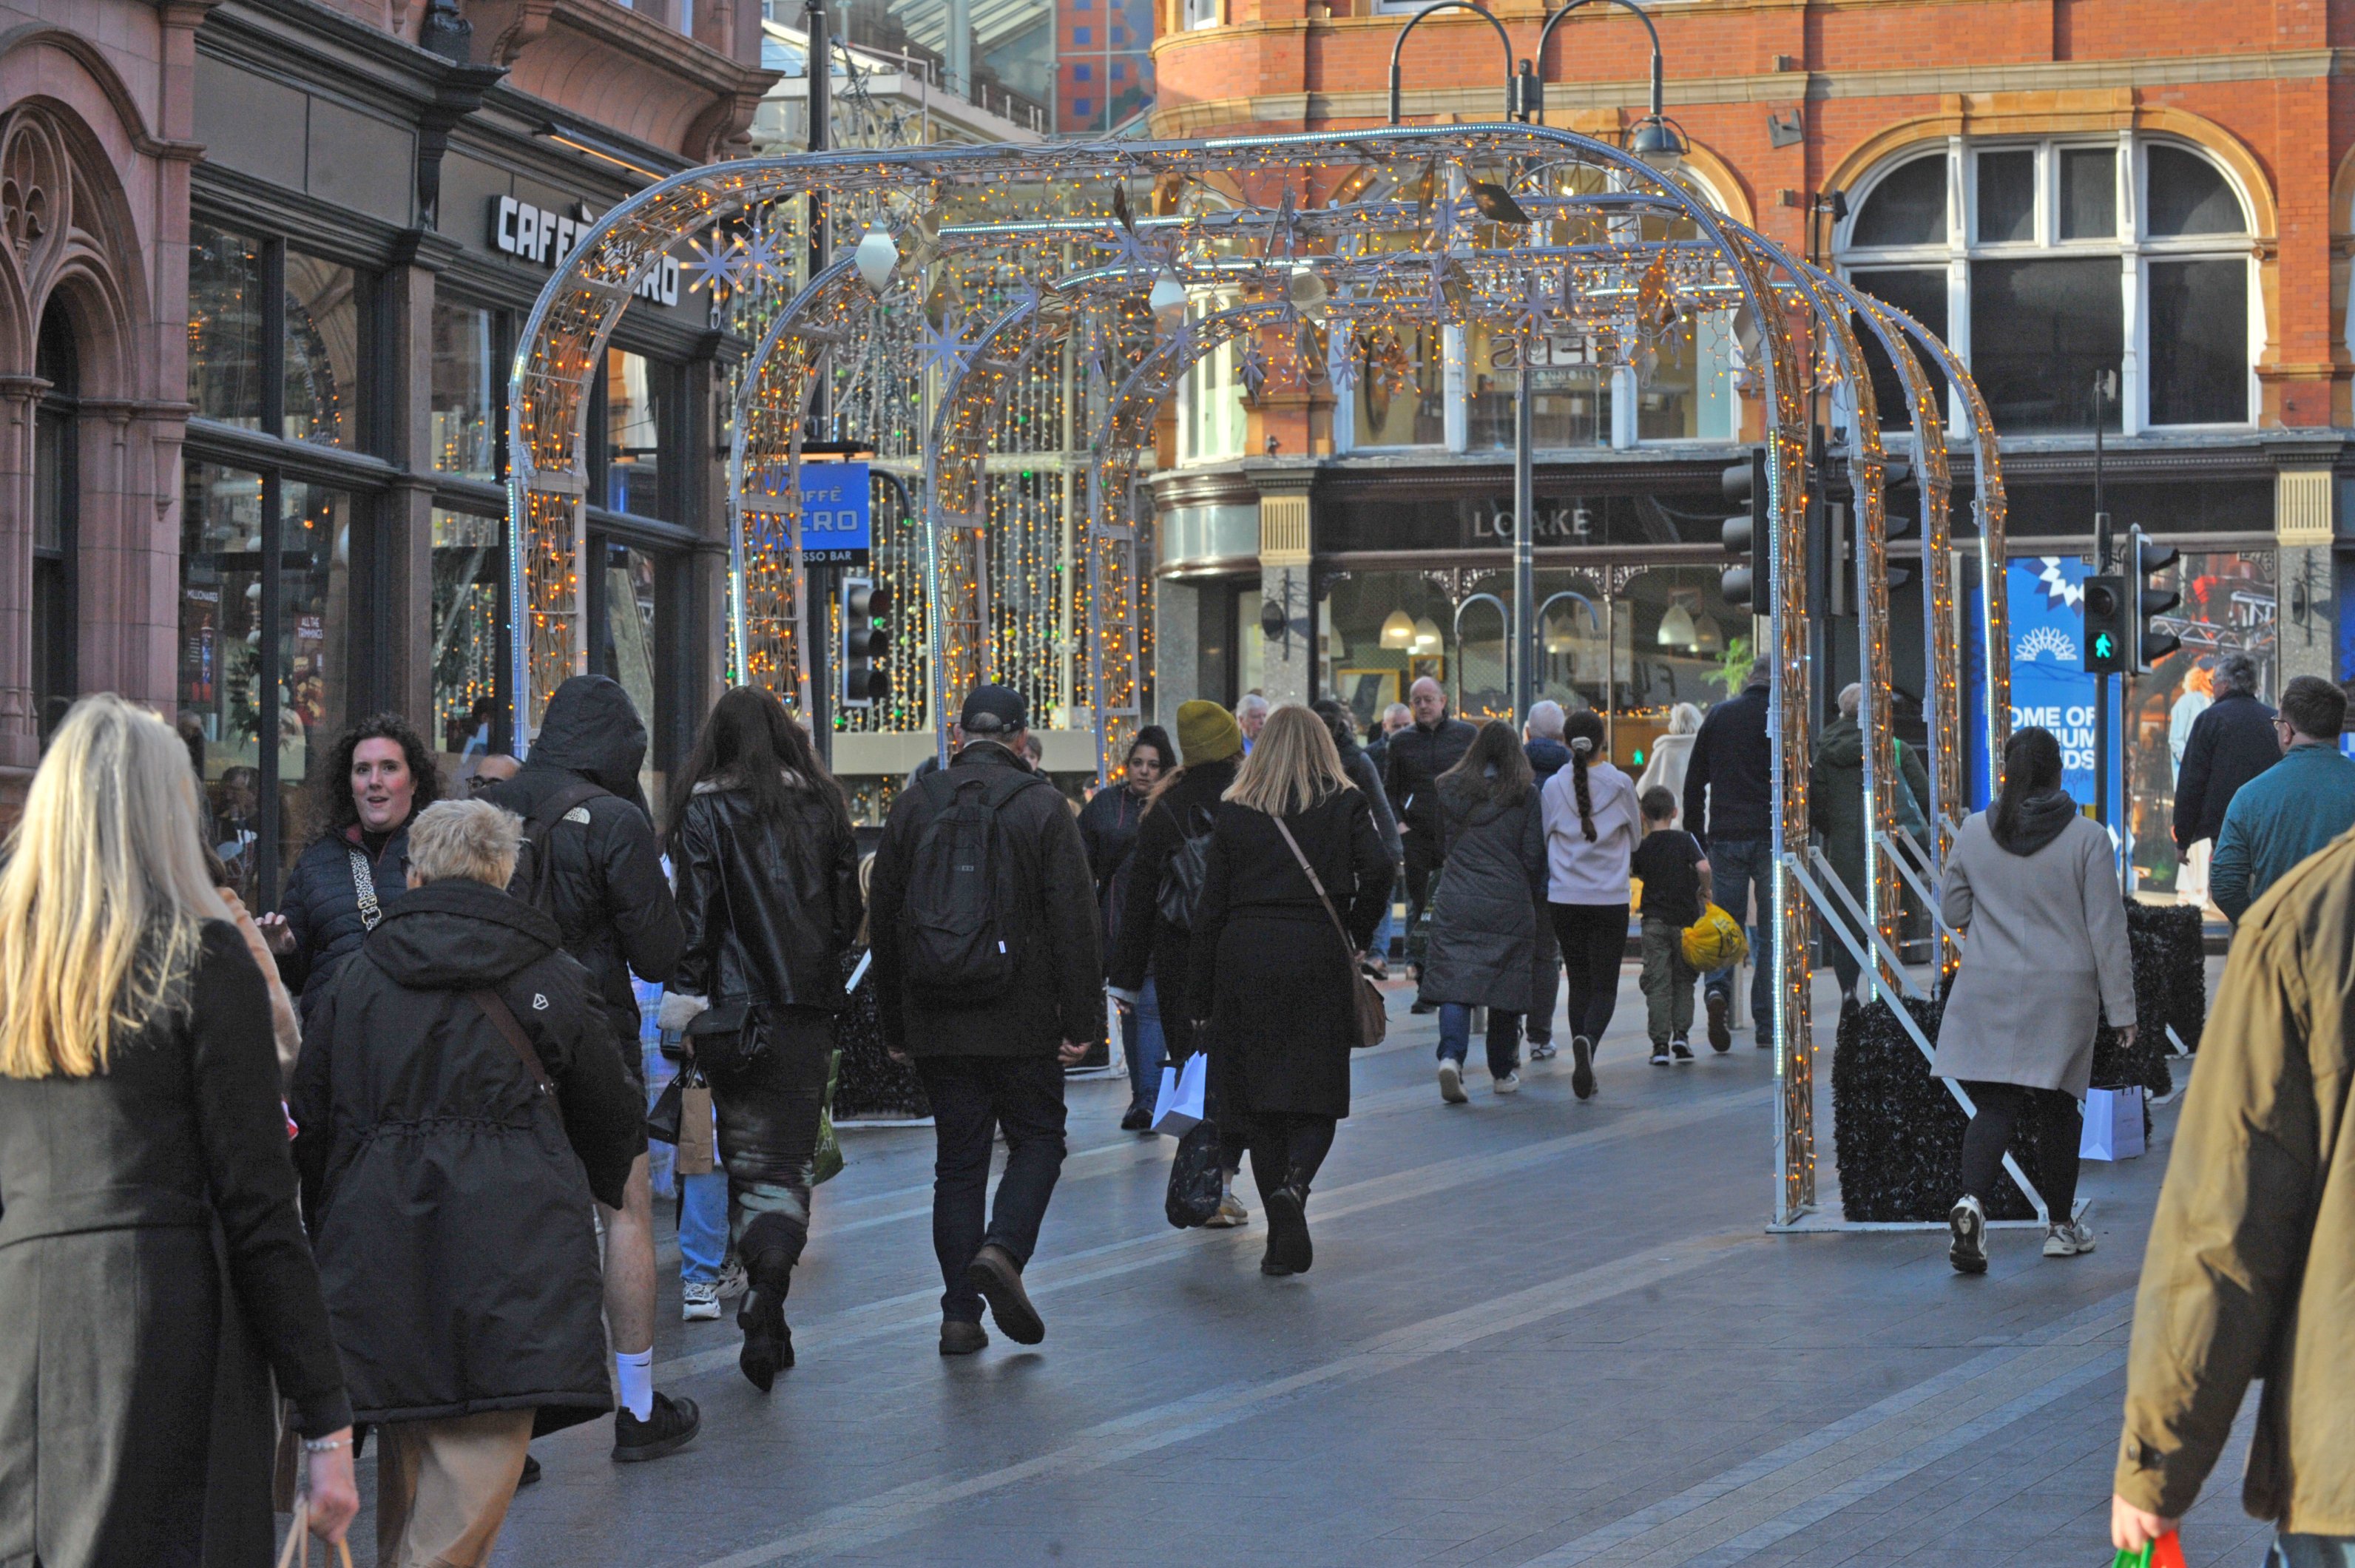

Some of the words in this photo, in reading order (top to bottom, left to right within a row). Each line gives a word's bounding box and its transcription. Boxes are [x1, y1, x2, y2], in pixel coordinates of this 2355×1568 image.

[1473, 508, 1592, 538] LOAKE
[829, 550, 852, 561] BAR
[2010, 706, 2061, 727] OME
